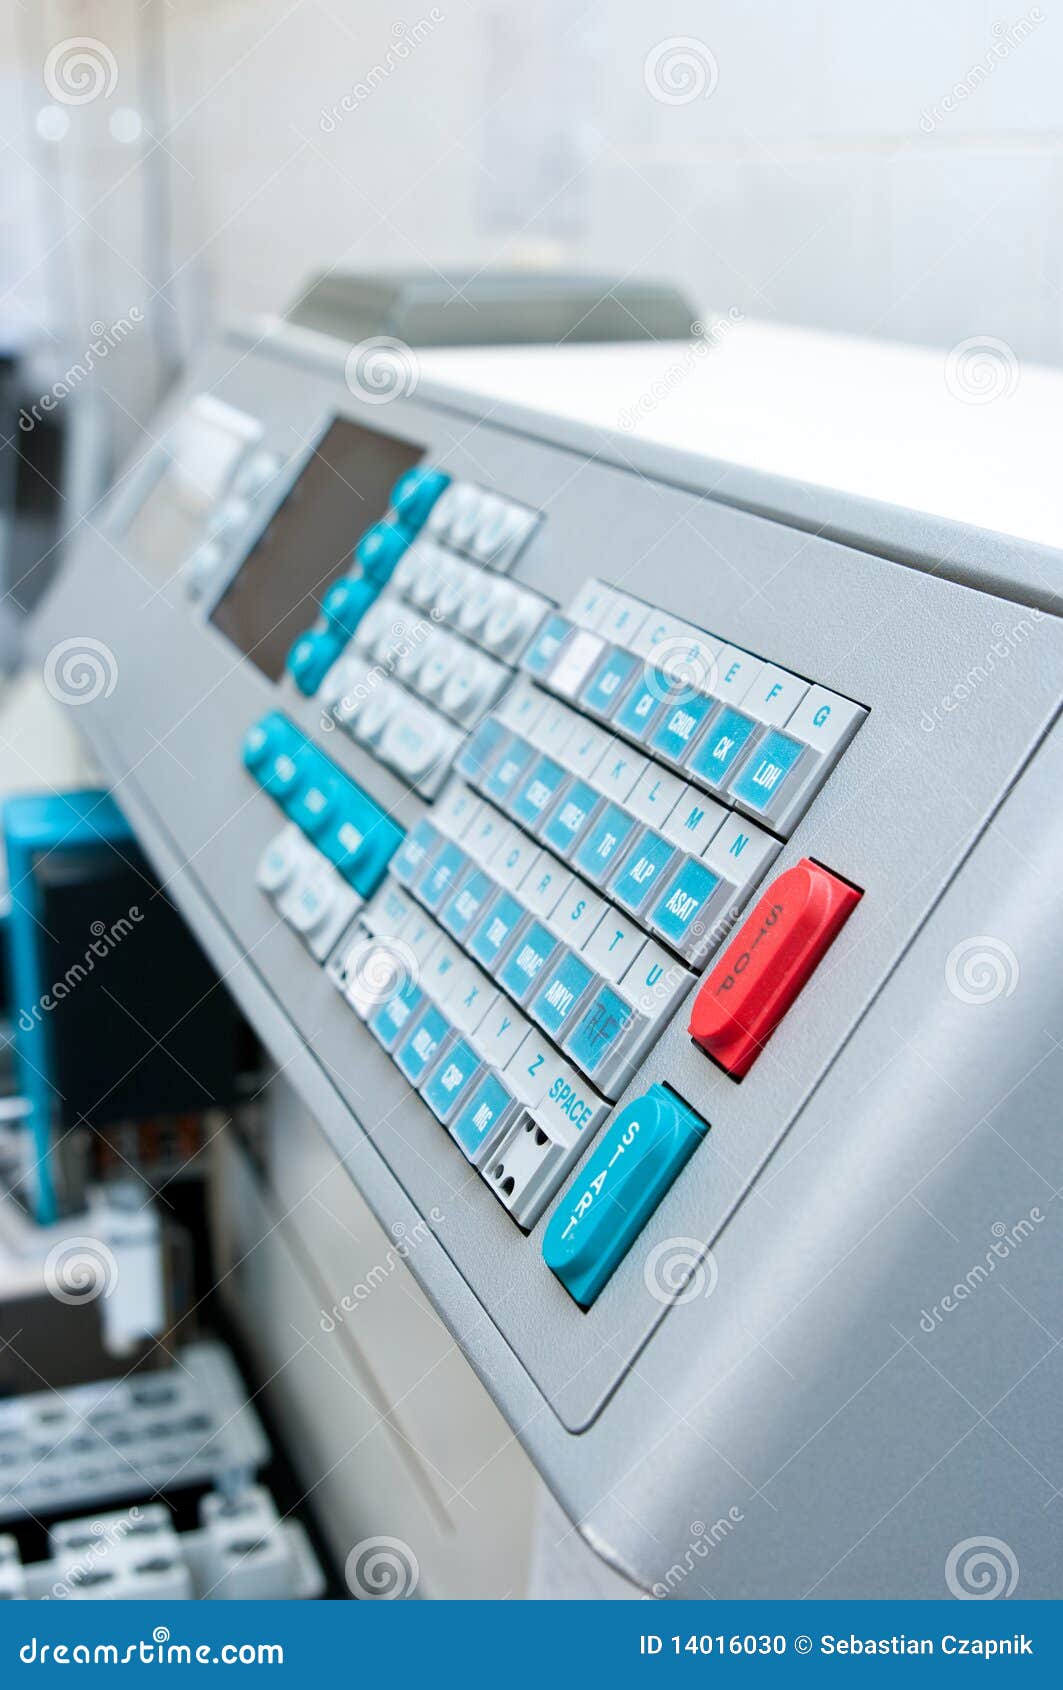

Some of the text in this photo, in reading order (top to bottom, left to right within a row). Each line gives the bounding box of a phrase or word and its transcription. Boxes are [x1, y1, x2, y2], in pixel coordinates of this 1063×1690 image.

[650, 625, 667, 645] C
[725, 663, 741, 683] E
[764, 683, 783, 702] F
[667, 709, 699, 742] CHOL
[813, 705, 831, 727] G
[711, 735, 736, 762] CK
[612, 760, 627, 780] K
[751, 759, 783, 791] LDH
[647, 780, 661, 803] L
[683, 806, 705, 832] M
[598, 832, 617, 858] TG
[729, 833, 749, 858] N
[630, 856, 656, 884] ALP
[538, 873, 553, 893] R
[571, 899, 587, 922] S
[664, 888, 700, 922] ASAT
[608, 930, 625, 951] T
[717, 904, 783, 996] STOP
[645, 963, 664, 987] U
[463, 985, 480, 1008] X
[544, 979, 575, 1017] AMYL
[496, 1016, 512, 1038] Y
[440, 1062, 464, 1092] CRP
[527, 1053, 545, 1077] Z
[549, 1077, 594, 1131] SPACE
[472, 1102, 493, 1133] MG
[560, 1120, 640, 1241] START
